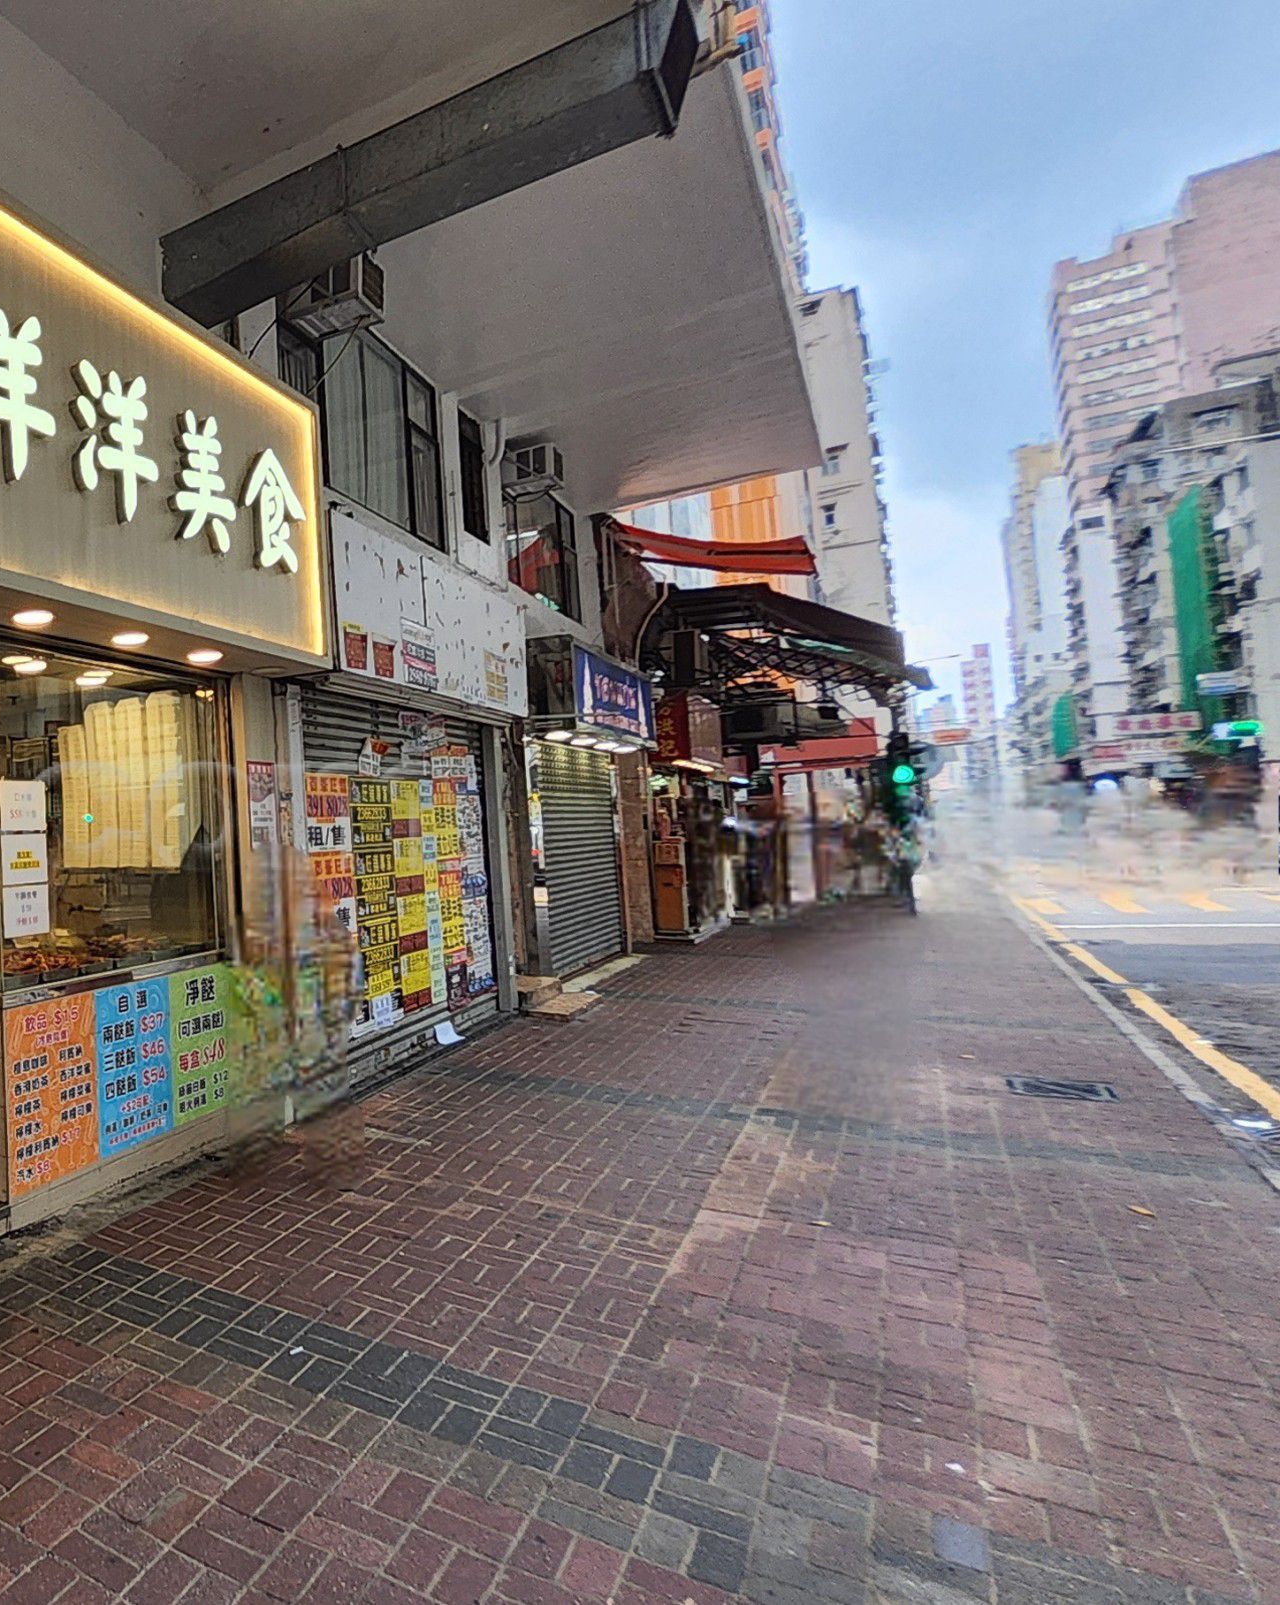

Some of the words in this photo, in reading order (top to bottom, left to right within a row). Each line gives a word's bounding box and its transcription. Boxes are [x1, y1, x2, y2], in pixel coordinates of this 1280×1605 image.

[308, 825, 346, 847] 租/售
[186, 975, 215, 1007] 淨餸
[25, 1013, 47, 1033] 飲品
[54, 1006, 79, 1025] $15
[140, 1012, 164, 1033] $37
[142, 1038, 165, 1060] $46
[180, 1050, 200, 1072] 每盒
[143, 1065, 167, 1087] $54
